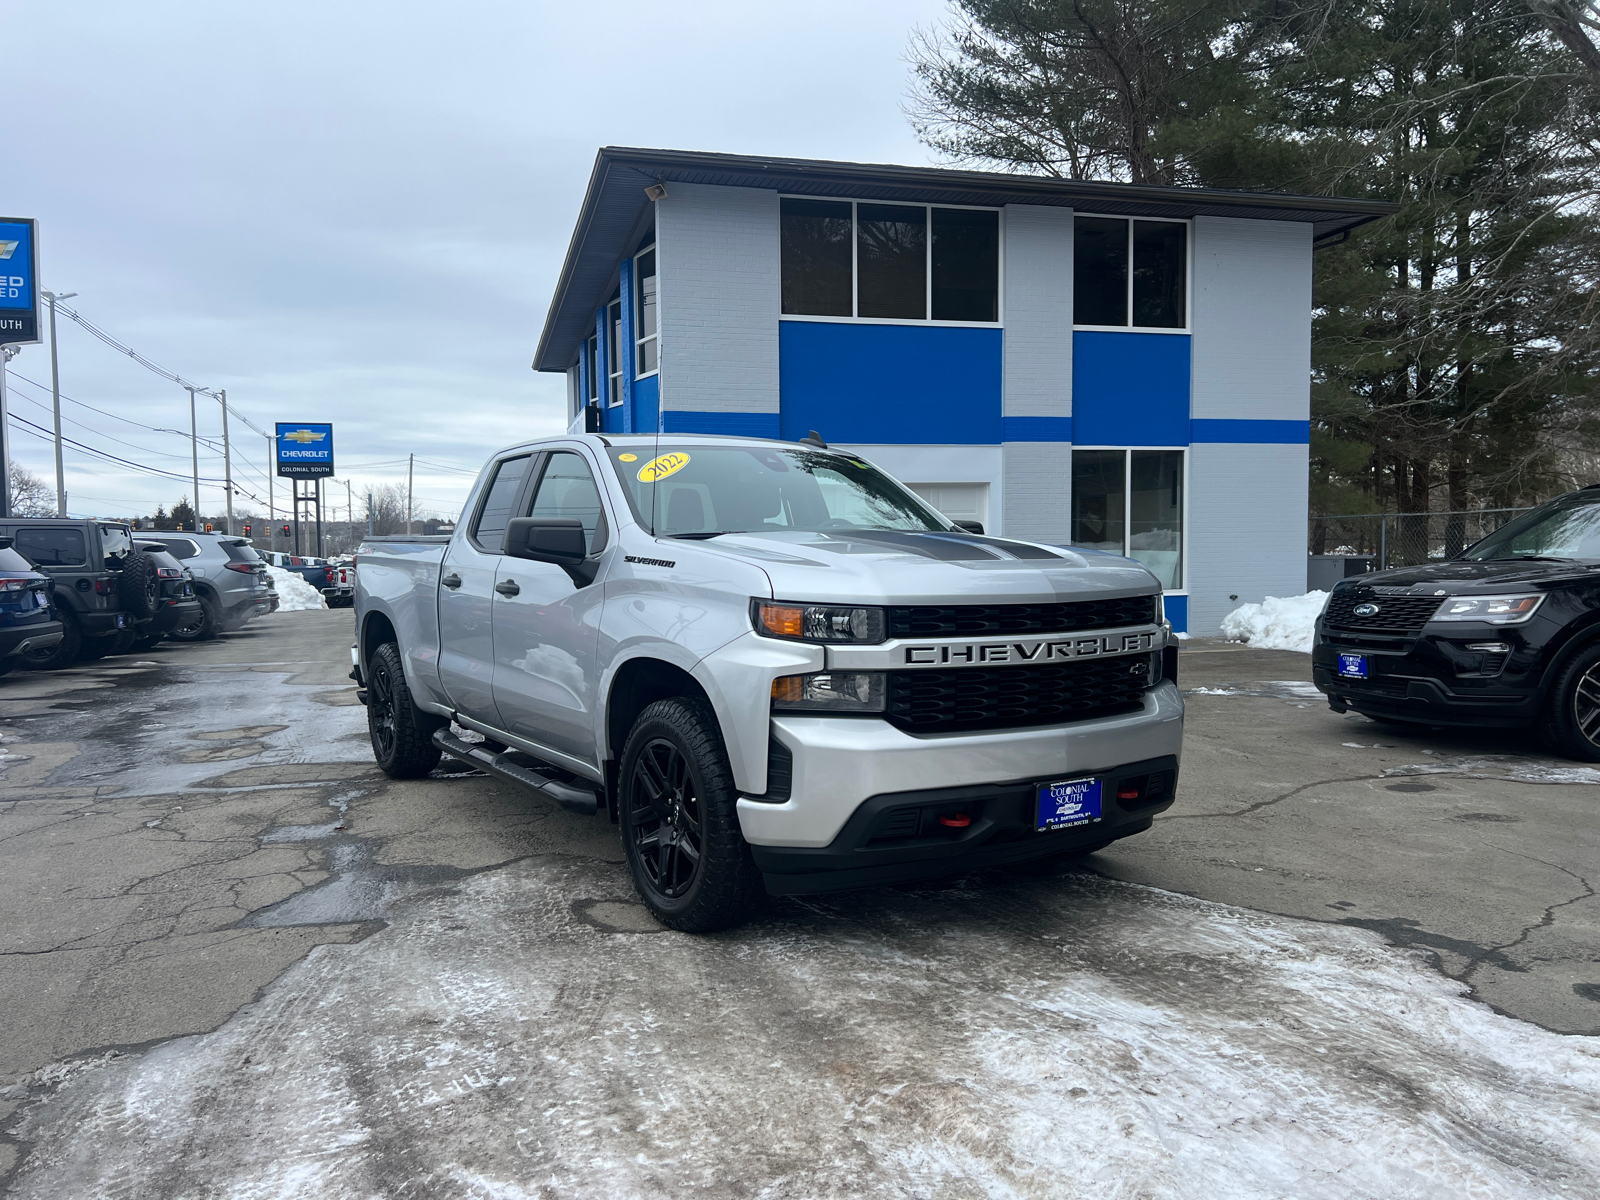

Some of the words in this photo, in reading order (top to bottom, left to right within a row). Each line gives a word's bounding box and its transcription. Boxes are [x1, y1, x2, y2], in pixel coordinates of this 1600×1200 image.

[281, 450, 329, 458] CHEVROLET
[647, 454, 683, 478] 2022
[623, 555, 676, 569] SILVERADO
[905, 632, 1157, 666] CHEVROLET
[1050, 784, 1089, 797] COLONIAL
[1055, 793, 1083, 805] SOUTH
[1051, 822, 1073, 830] COLONIAL
